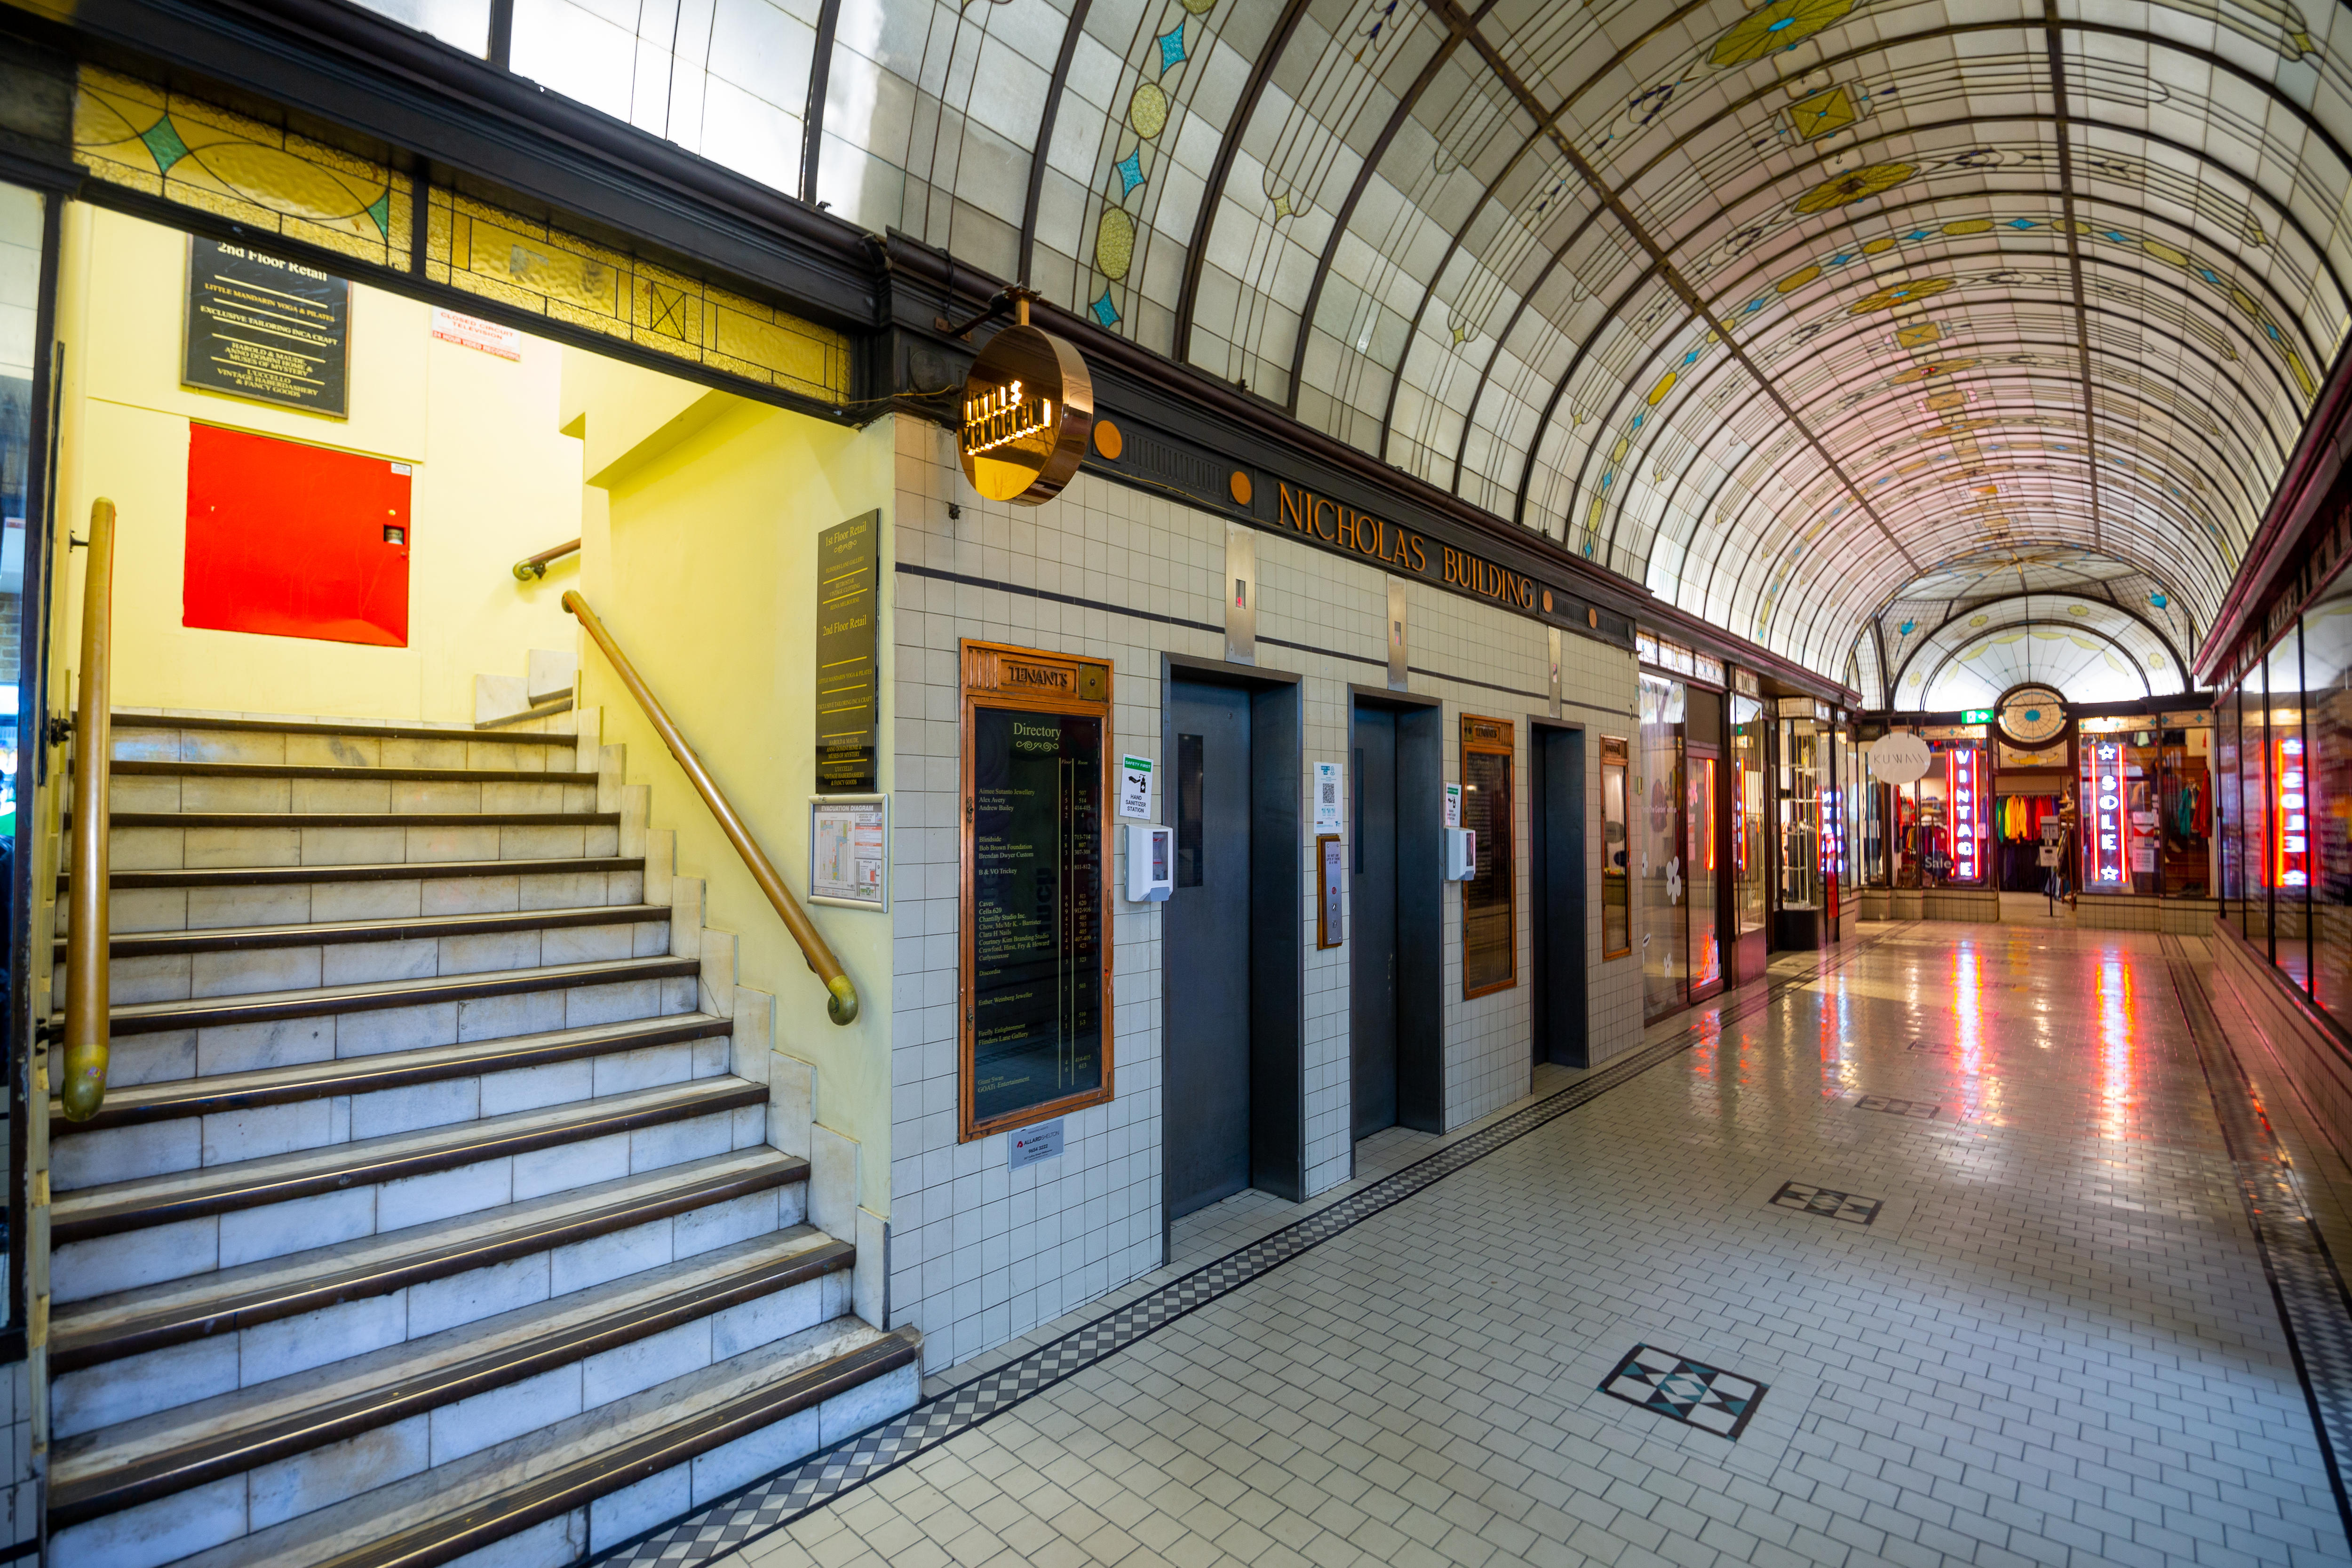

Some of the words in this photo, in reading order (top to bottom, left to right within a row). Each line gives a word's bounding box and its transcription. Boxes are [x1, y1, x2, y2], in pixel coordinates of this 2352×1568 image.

[217, 242, 245, 258] 2nd
[248, 249, 286, 270] Floor
[205, 283, 232, 295] LITTLE
[233, 290, 276, 306] MANDARIN
[277, 302, 298, 312] YOGA
[307, 310, 335, 322] PILATES
[200, 305, 247, 322] EXCLUSIVE
[248, 318, 291, 334] TAILORING
[292, 329, 311, 339] INCA
[312, 334, 338, 345] CRAFT
[441, 311, 476, 326] CLOSED
[479, 323, 514, 337] CIRCUIT
[453, 322, 502, 340] TELEVISION
[225, 347, 249, 357] ANNO
[282, 360, 306, 370] HOME
[232, 342, 267, 355] HAROLD
[230, 353, 257, 365] MUSES
[270, 363, 308, 376] MYSTERY
[217, 367, 254, 382] VINTAGE
[254, 376, 318, 396] HABERDASHERY
[244, 380, 272, 391] FANCY
[272, 386, 301, 398] GOODS
[834, 530, 849, 543] Floor
[850, 520, 866, 537] Retail
[1277, 482, 1426, 572] NICHOLAS
[1443, 546, 1533, 609] BUILDING
[823, 624, 833, 636] 2nd
[834, 620, 849, 633] Floor
[850, 614, 866, 629] Retail
[1009, 666, 1068, 687] TENANTS
[1013, 723, 1062, 740] Directory
[1955, 750, 1972, 877] VINTAGE
[1924, 856, 1952, 869] Sale
[994, 1024, 1025, 1034] Enlightenment
